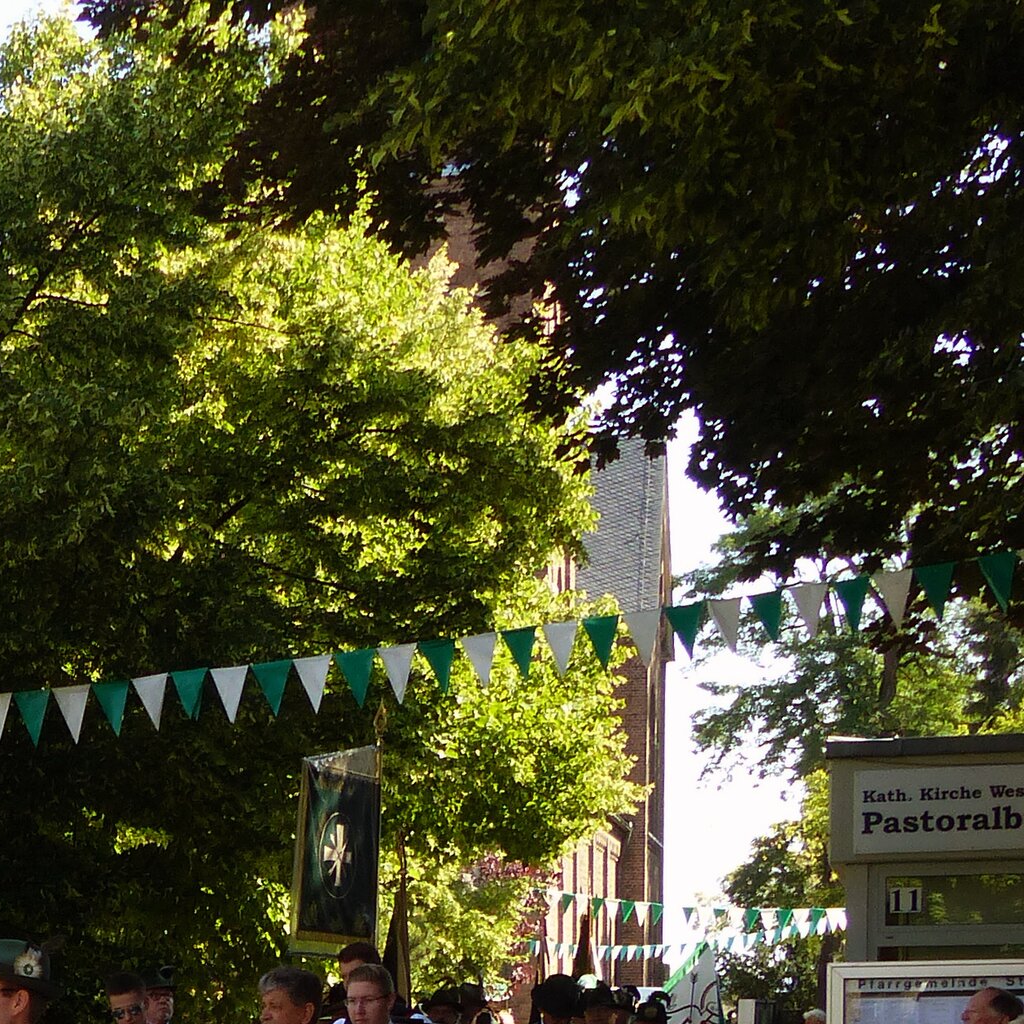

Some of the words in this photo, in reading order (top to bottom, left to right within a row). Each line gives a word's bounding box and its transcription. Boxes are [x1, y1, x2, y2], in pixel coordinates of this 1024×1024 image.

[862, 788, 913, 804] Kath.
[920, 786, 982, 801] Kirche
[861, 806, 1023, 835] Pastoralb
[891, 889, 919, 912] 11
